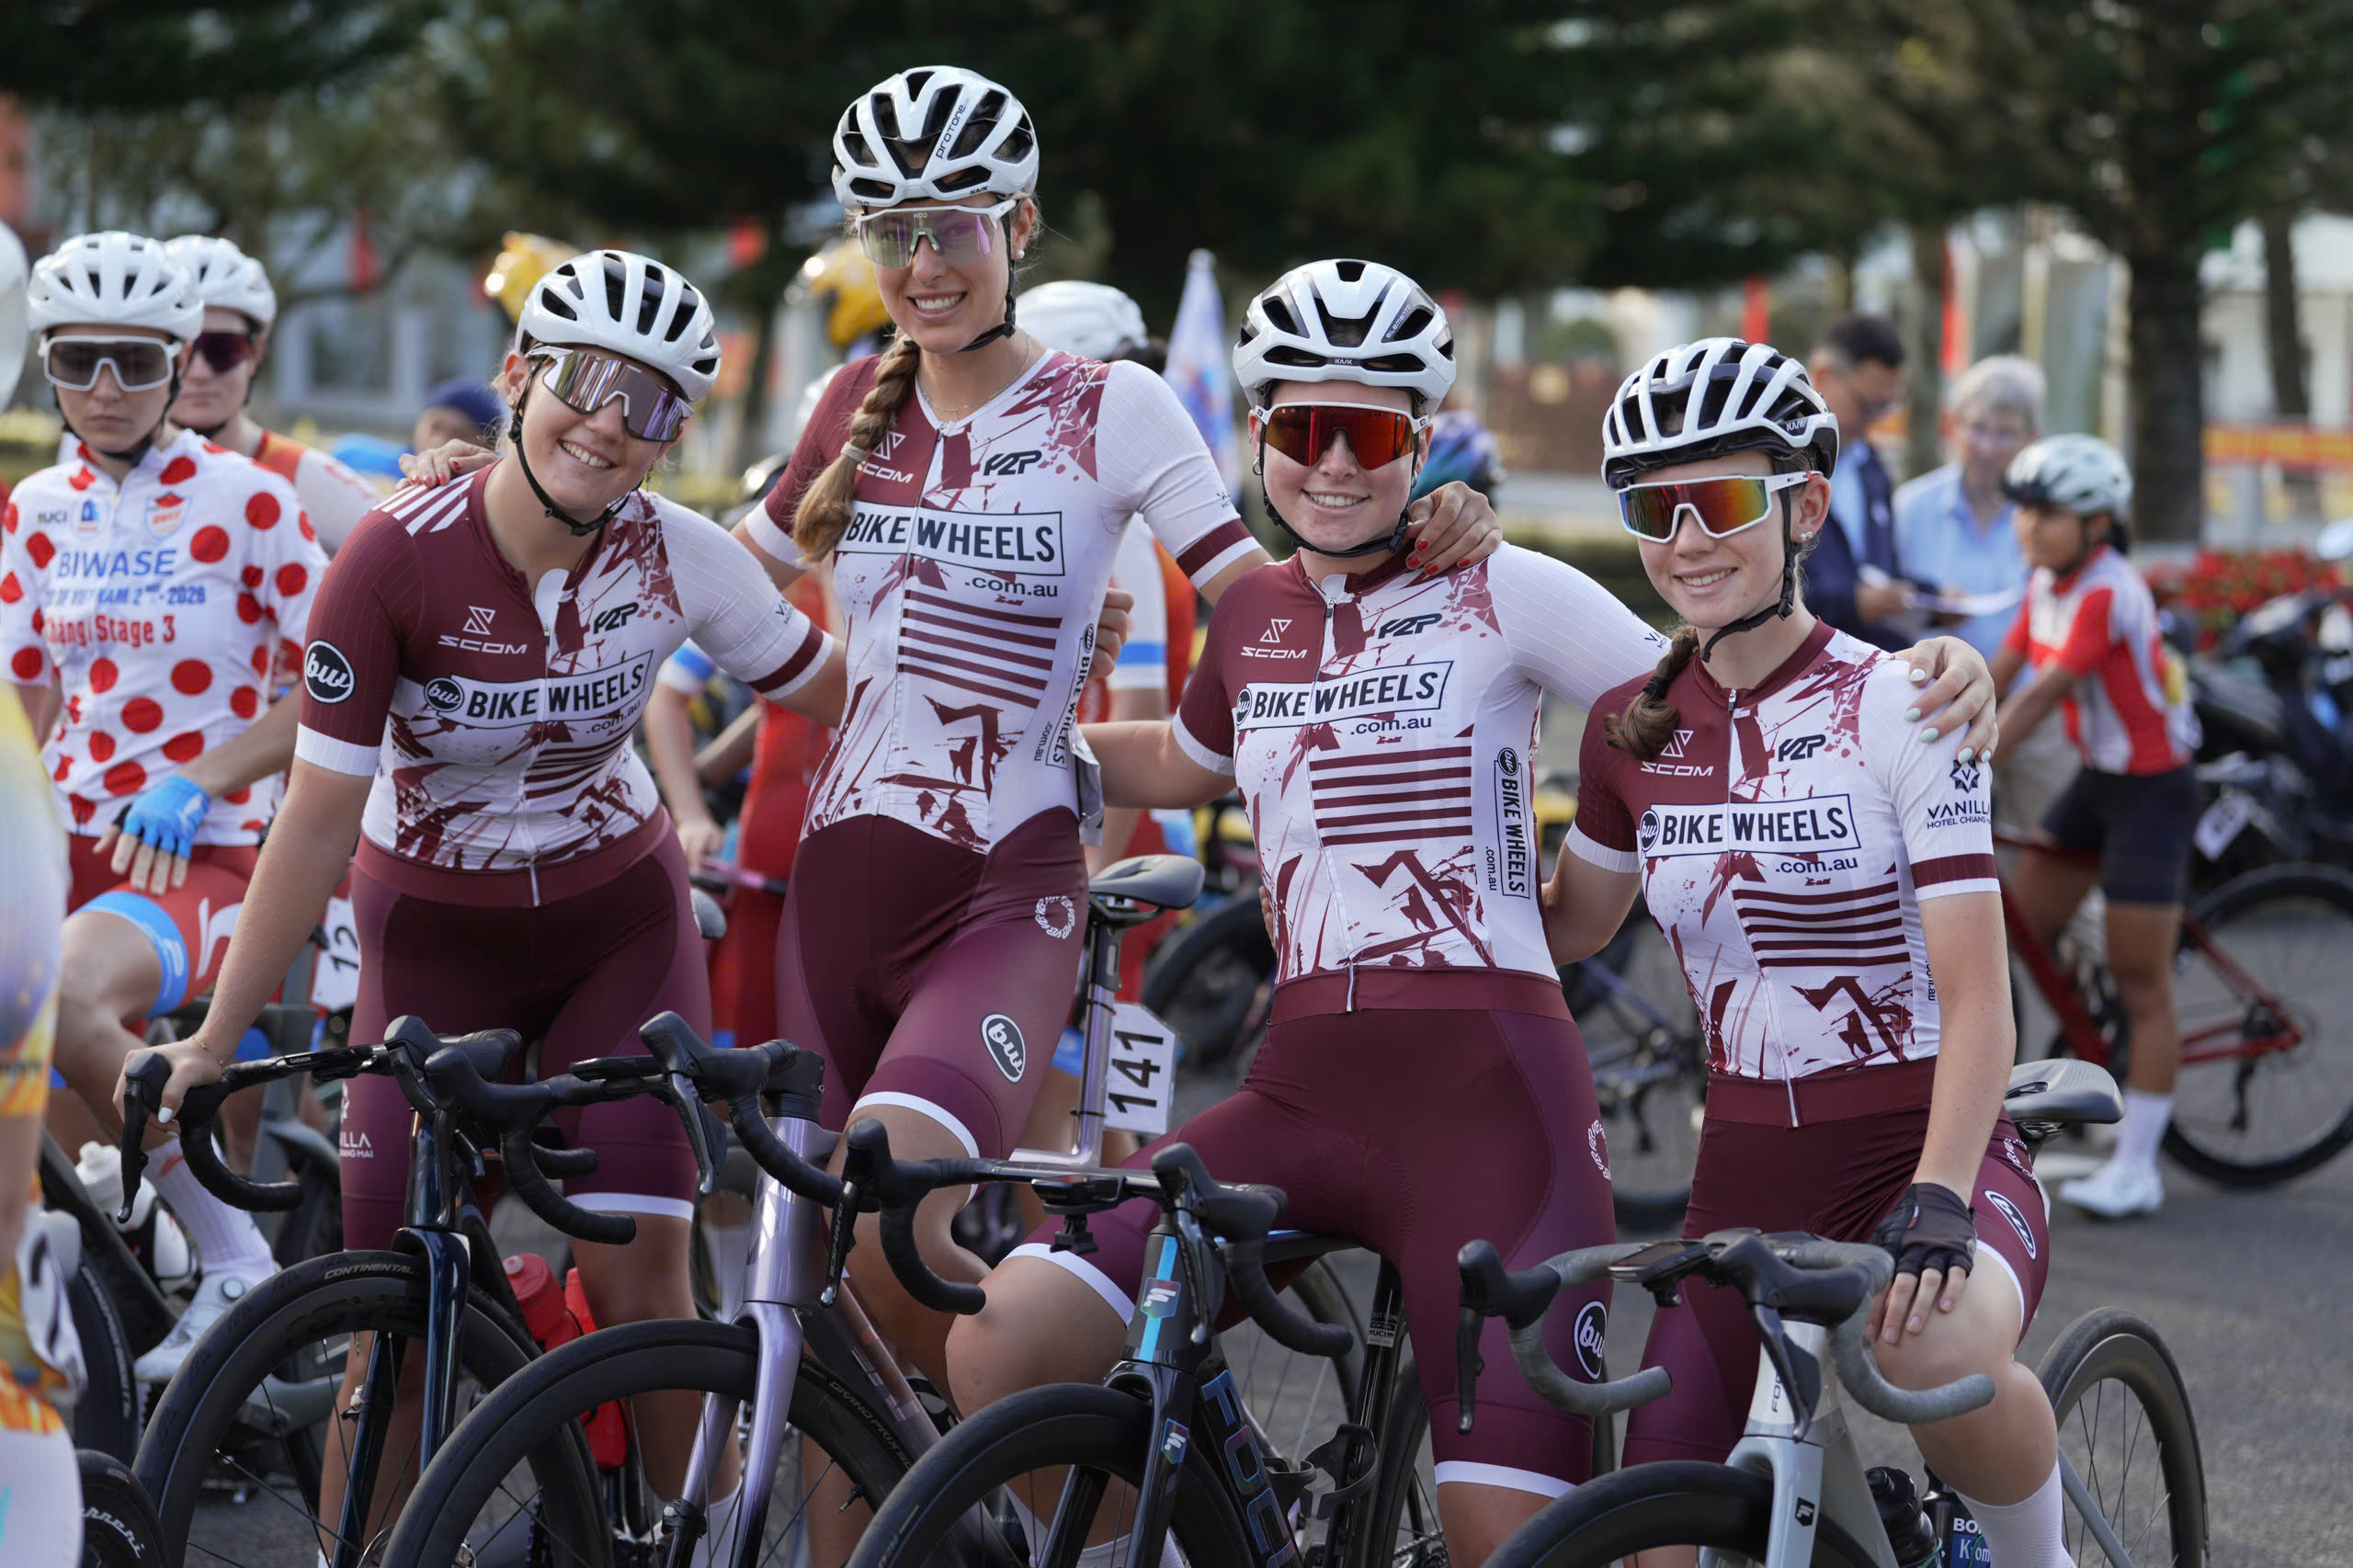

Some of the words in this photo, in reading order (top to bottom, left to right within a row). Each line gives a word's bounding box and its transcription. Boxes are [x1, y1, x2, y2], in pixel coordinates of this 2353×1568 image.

[846, 512, 911, 544] BIKE
[917, 517, 1055, 562] WHEELS
[58, 550, 177, 578] BIWASE
[965, 576, 1058, 597] .com.au
[438, 634, 528, 654] SCOM
[1241, 645, 1308, 659] SCOM
[1073, 656, 1090, 696] BIKE
[466, 687, 540, 720] BIKE
[549, 664, 644, 712] WHEELS
[1252, 691, 1310, 719] BIKE
[1315, 672, 1438, 714] WHEELS
[585, 699, 641, 733] .com.au
[1350, 717, 1432, 735] .com.au
[1641, 761, 1714, 778] SCOM
[1502, 778, 1522, 820] BIKE
[1662, 813, 1723, 846] BIKE
[1733, 807, 1848, 842] WHEELS
[1927, 817, 1958, 830] HOTEL
[1485, 846, 1497, 891] .com.au
[1506, 824, 1526, 893] WHEELS
[1776, 857, 1859, 874] .com.au
[1108, 1030, 1164, 1114] 141
[324, 1263, 414, 1280] CONTINENTAL
[1953, 1517, 1982, 1534] BO
